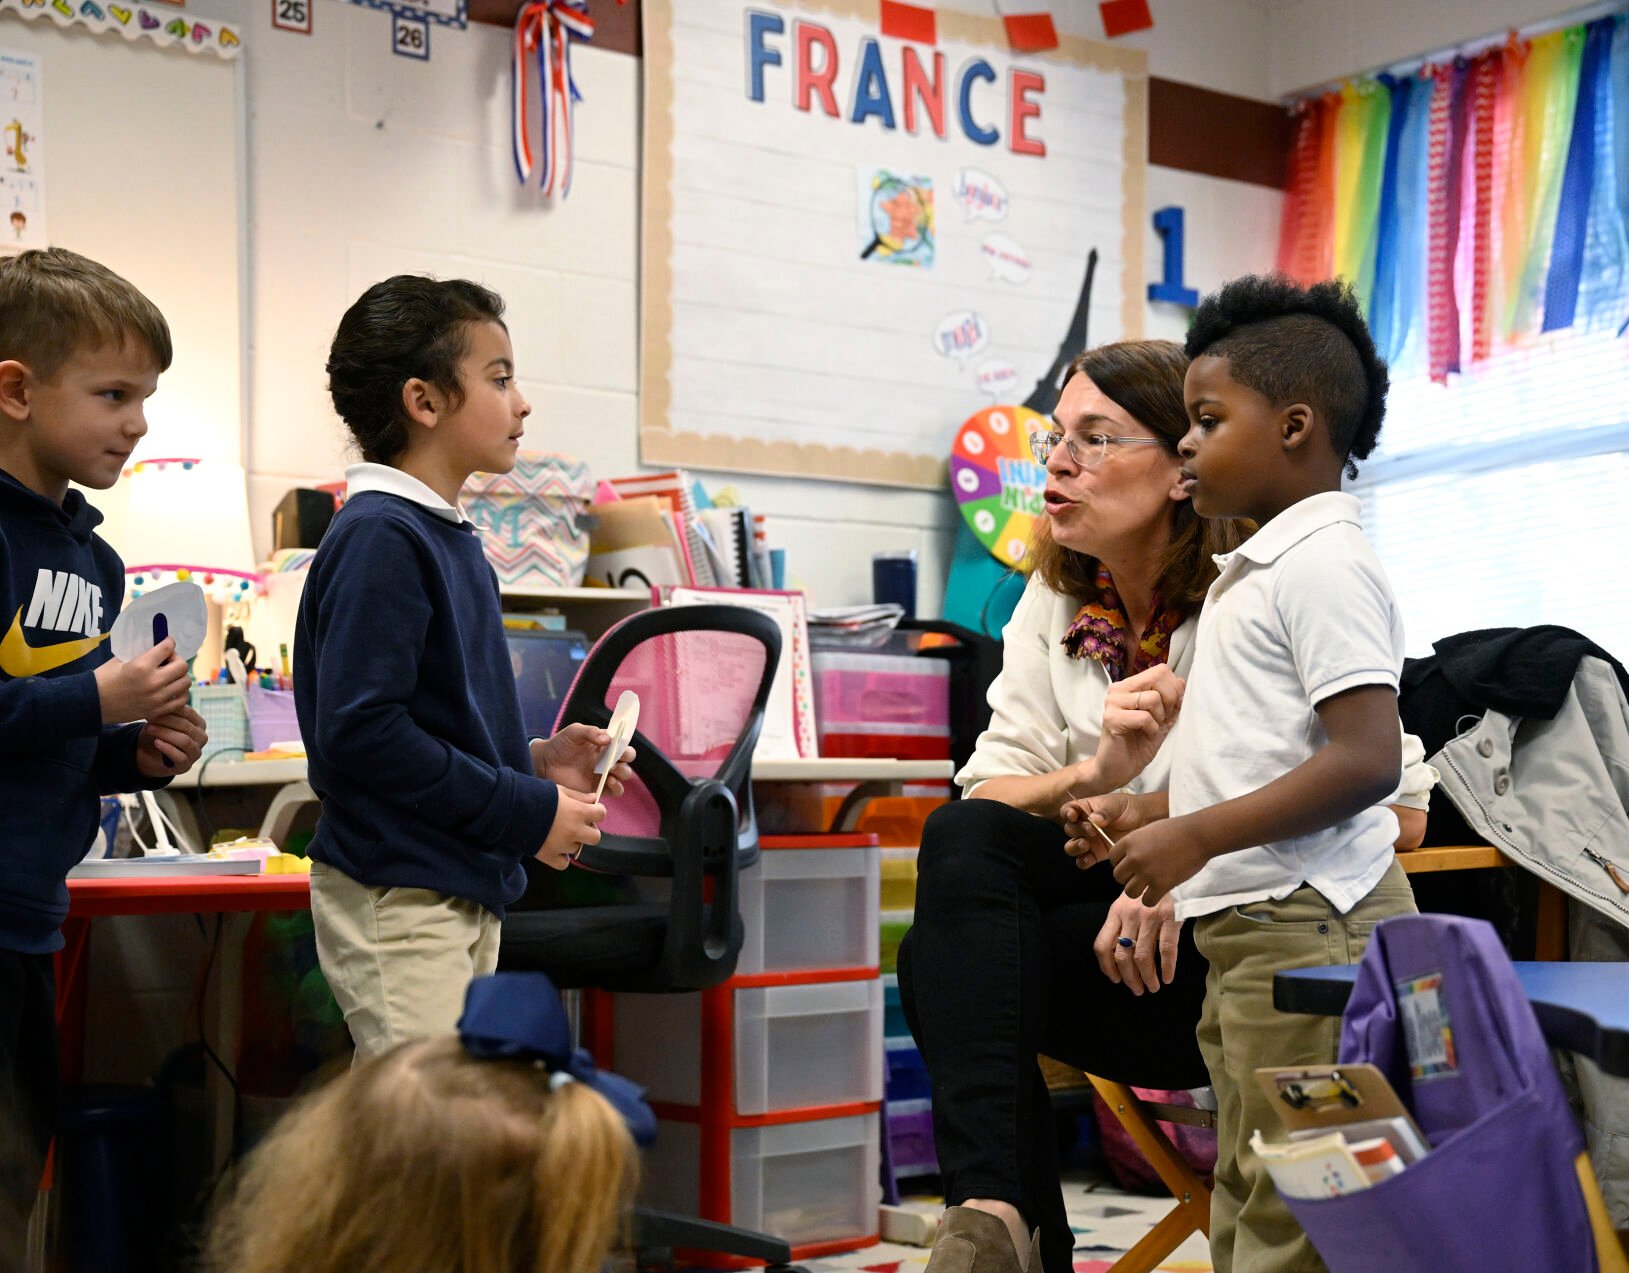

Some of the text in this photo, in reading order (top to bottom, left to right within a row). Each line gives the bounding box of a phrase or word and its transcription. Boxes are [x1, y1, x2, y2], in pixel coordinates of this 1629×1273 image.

[280, 0, 306, 23] 25
[399, 26, 423, 49] 26
[747, 9, 1046, 158] FRANCE
[1147, 207, 1199, 308] 1
[23, 568, 104, 638] NIKE
